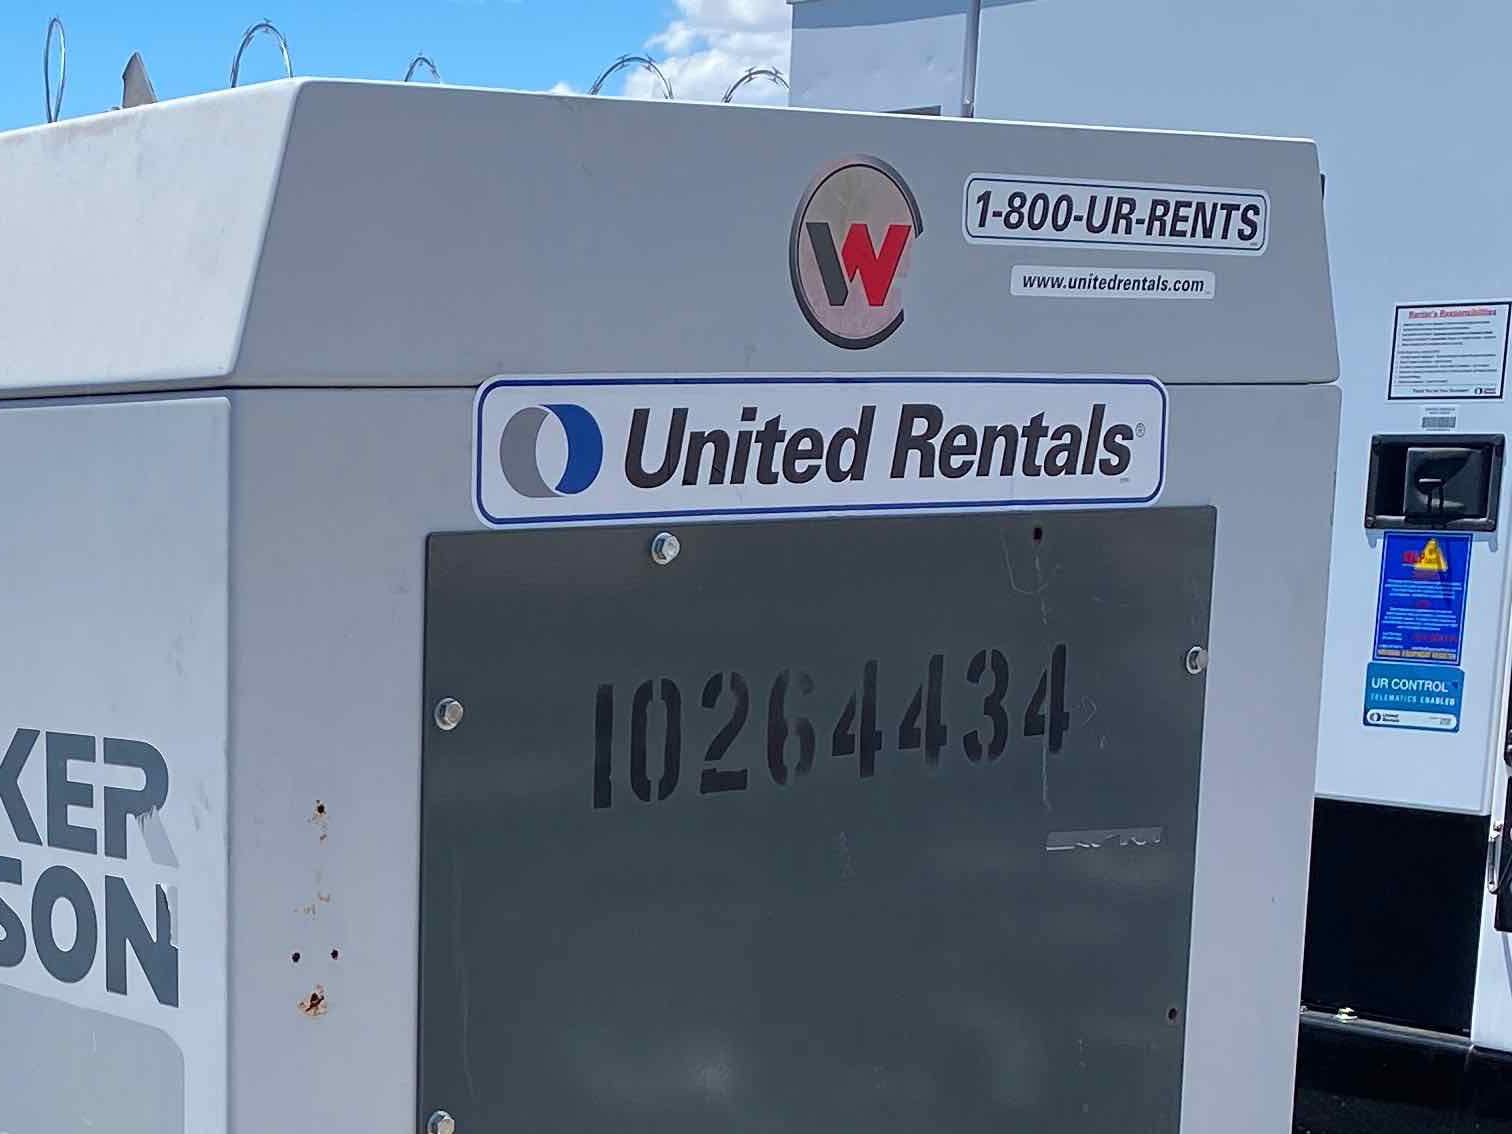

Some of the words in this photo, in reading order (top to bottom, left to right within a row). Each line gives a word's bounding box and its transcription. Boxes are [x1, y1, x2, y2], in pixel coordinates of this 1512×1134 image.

[976, 190, 1261, 242] 1-800-UR-RENTS
[1022, 273, 1205, 293] www.unitedrentals.com
[623, 405, 878, 490] United
[1371, 678, 1389, 689] UR
[1391, 679, 1449, 693] CONTROL
[593, 643, 1071, 809] 10264434
